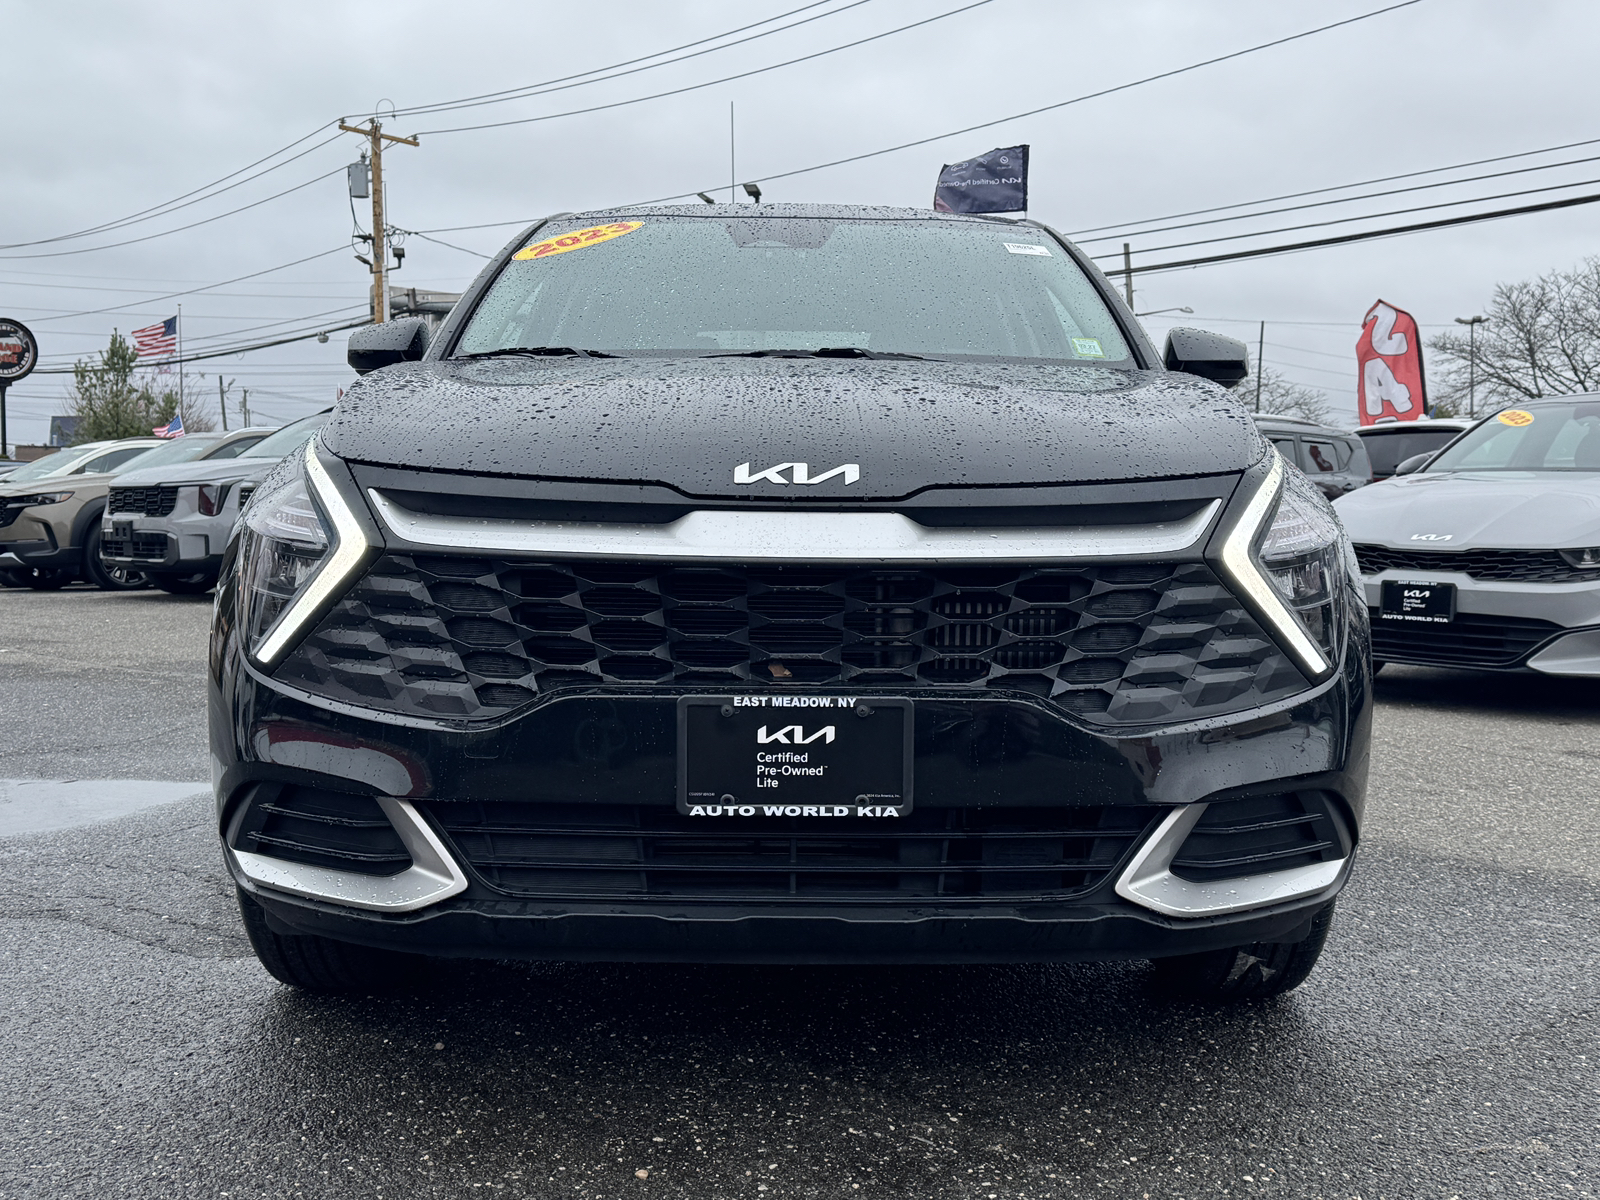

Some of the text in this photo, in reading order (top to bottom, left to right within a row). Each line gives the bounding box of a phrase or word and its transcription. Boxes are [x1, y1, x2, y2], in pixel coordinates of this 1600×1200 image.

[530, 222, 634, 257] 2023
[1499, 411, 1531, 425] 2023
[734, 462, 860, 486] KIA
[1410, 533, 1453, 542] KIA
[1403, 589, 1430, 598] KIA
[733, 697, 768, 707] EAST
[837, 697, 857, 708] NY
[757, 724, 836, 744] KIA
[757, 751, 808, 763] Certified
[757, 777, 779, 788] Lite
[689, 806, 899, 817] AUTO WORLD KIA
